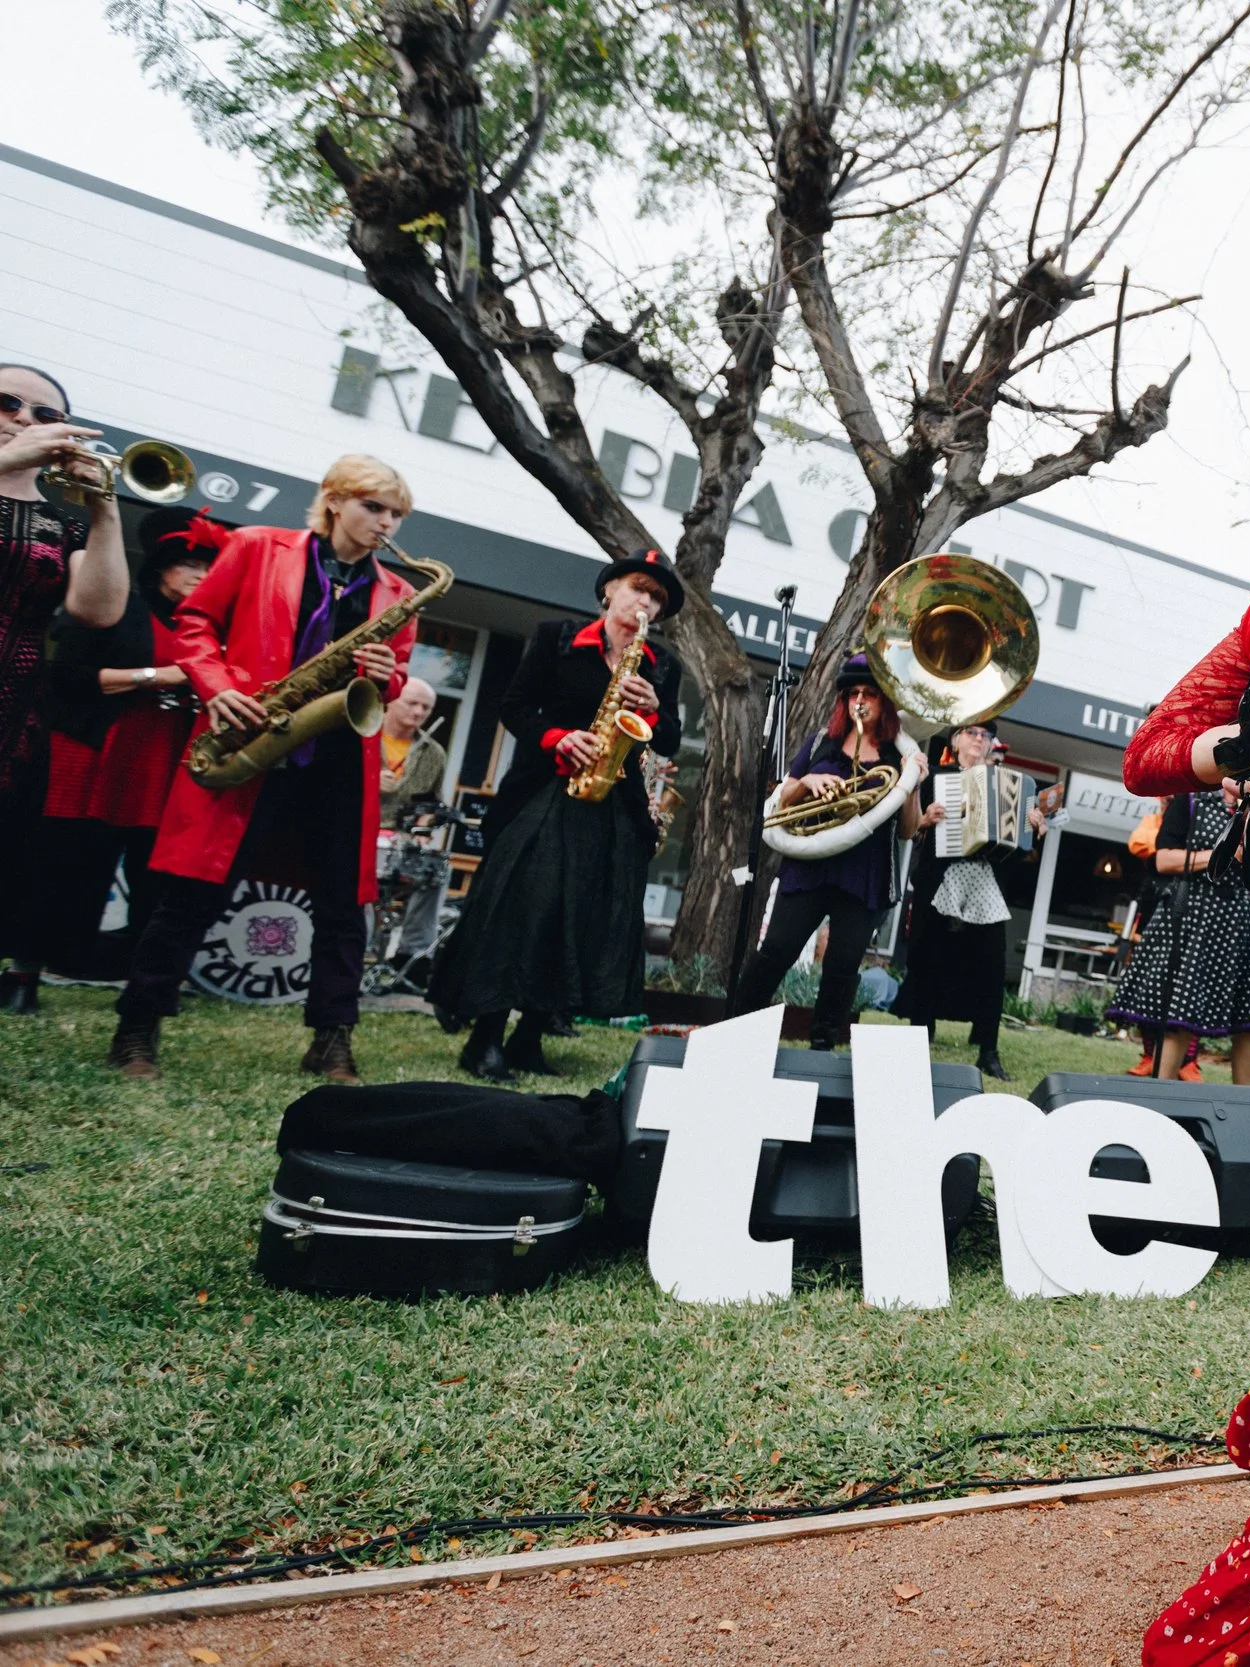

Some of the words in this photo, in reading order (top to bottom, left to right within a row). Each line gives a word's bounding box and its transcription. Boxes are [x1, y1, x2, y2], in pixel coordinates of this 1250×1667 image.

[712, 604, 819, 655] ALLE
[1082, 703, 1147, 738] LITT
[636, 1003, 1221, 1310] the
